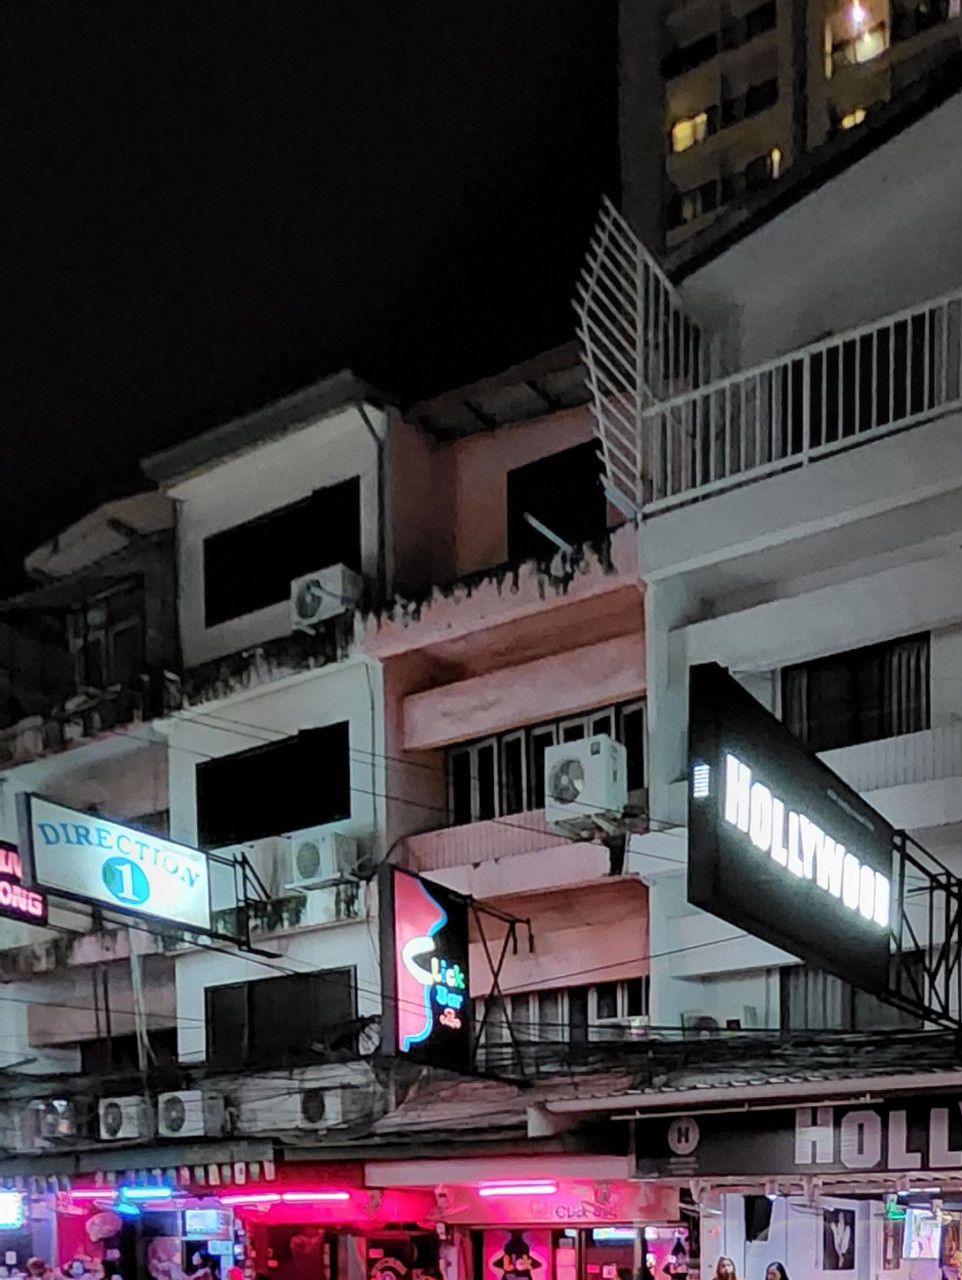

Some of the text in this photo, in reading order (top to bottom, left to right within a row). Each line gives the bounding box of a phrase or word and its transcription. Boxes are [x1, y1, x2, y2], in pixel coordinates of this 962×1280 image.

[38, 823, 200, 887] DIRECTION
[725, 753, 890, 928] HOLLYWOOD
[114, 863, 140, 900] 1
